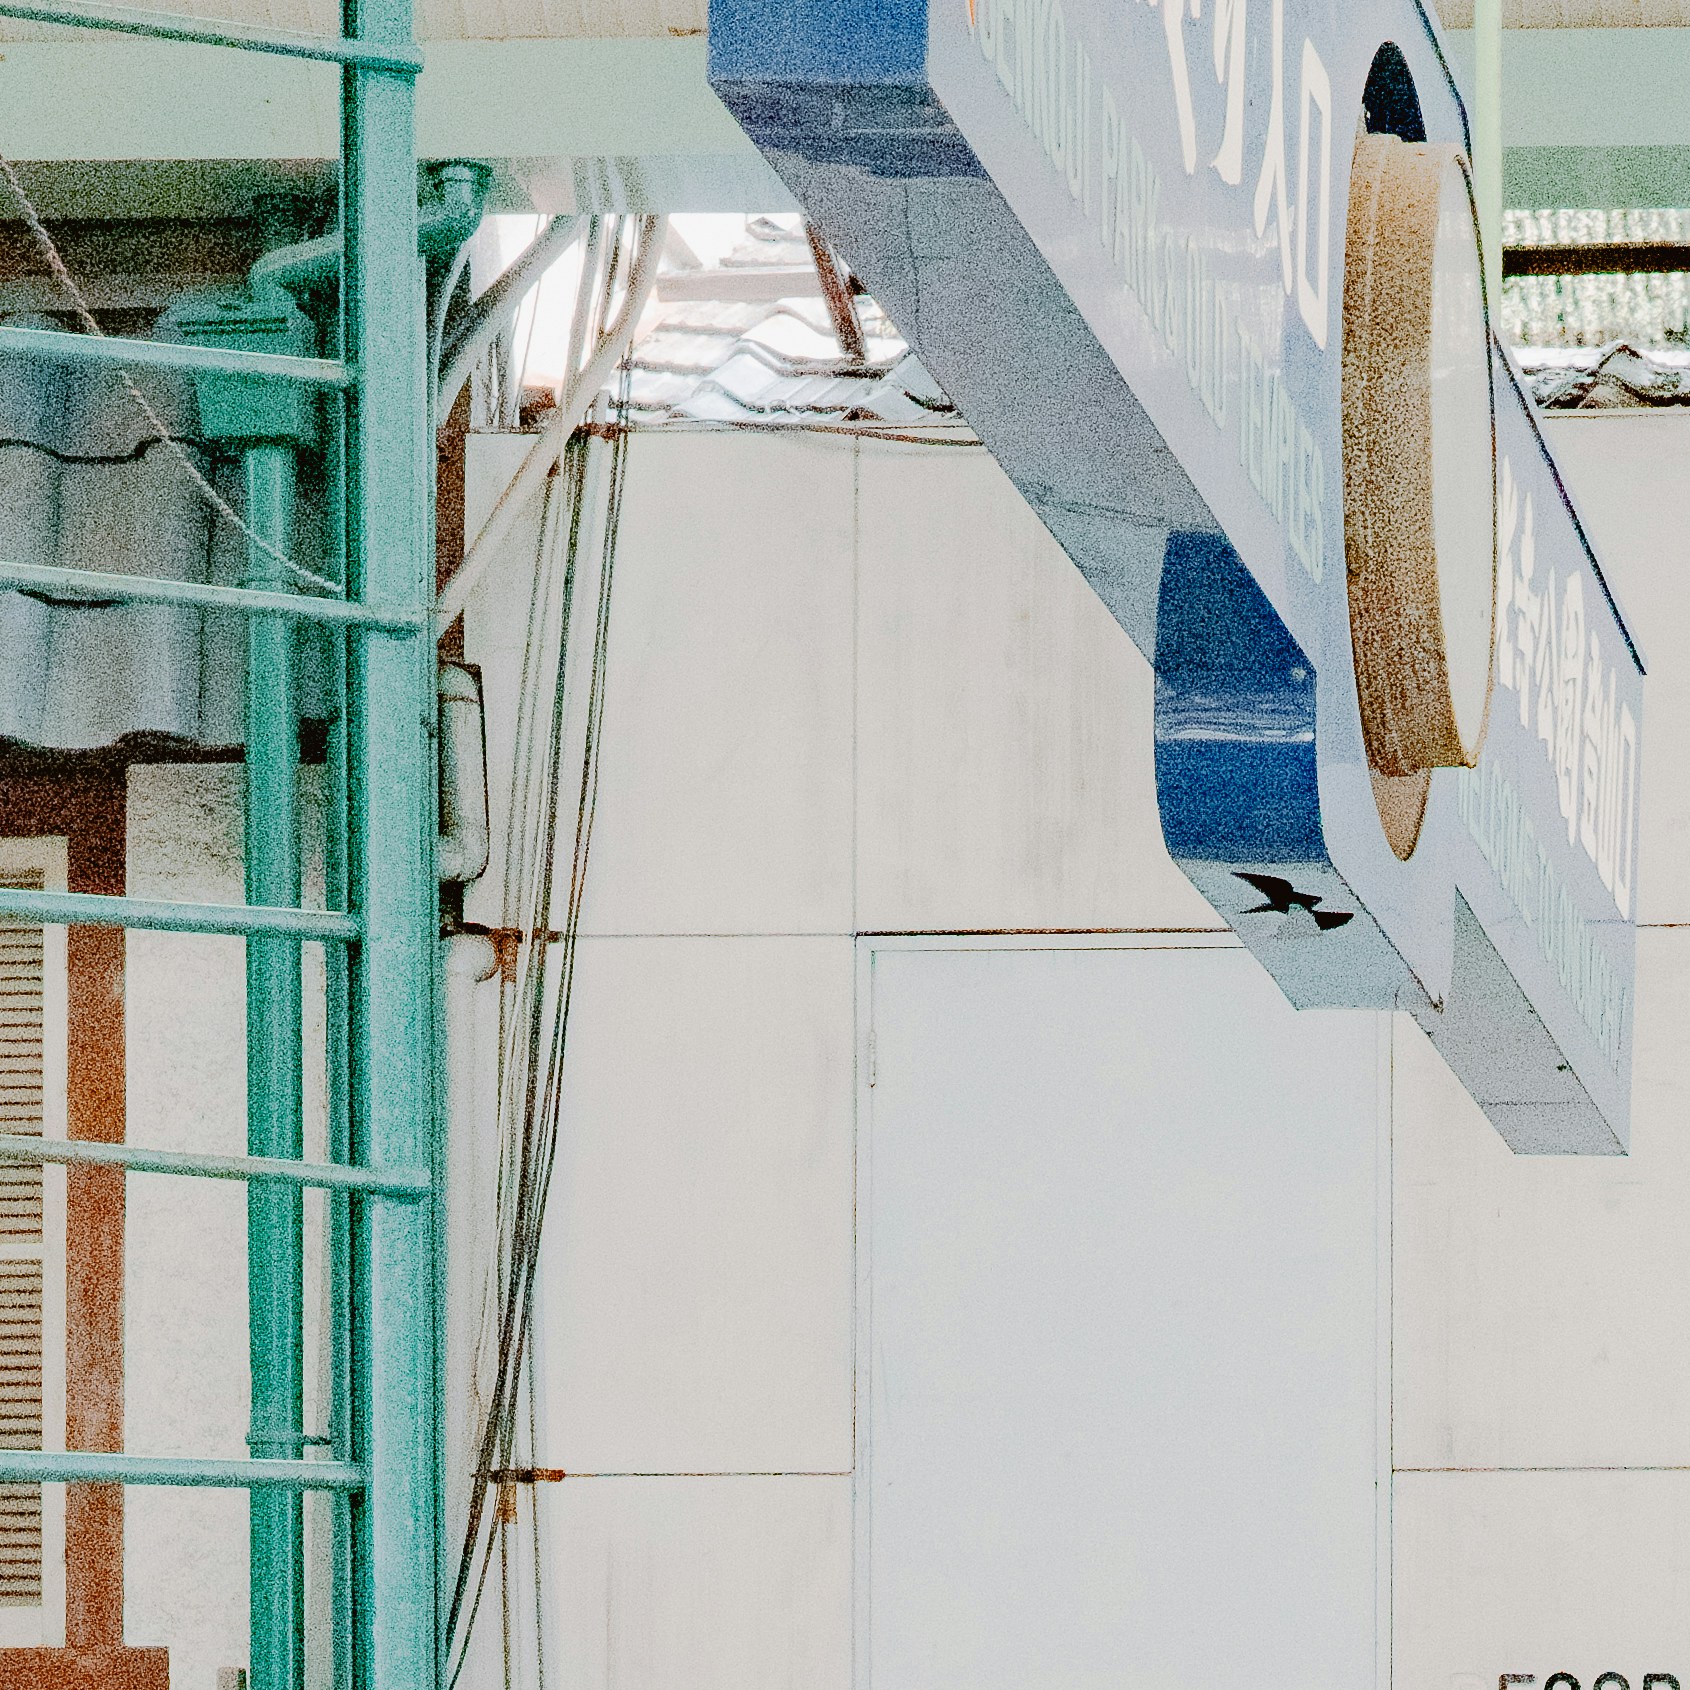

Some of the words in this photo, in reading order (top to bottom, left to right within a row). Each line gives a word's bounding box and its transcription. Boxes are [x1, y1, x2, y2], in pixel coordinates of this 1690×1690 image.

[1101, 83, 1162, 333] PARK
[1164, 229, 1178, 355] &
[1185, 234, 1230, 431] OLD
[1236, 320, 1325, 585] TEMPLES
[1496, 453, 1636, 921] 光寺公園登山口
